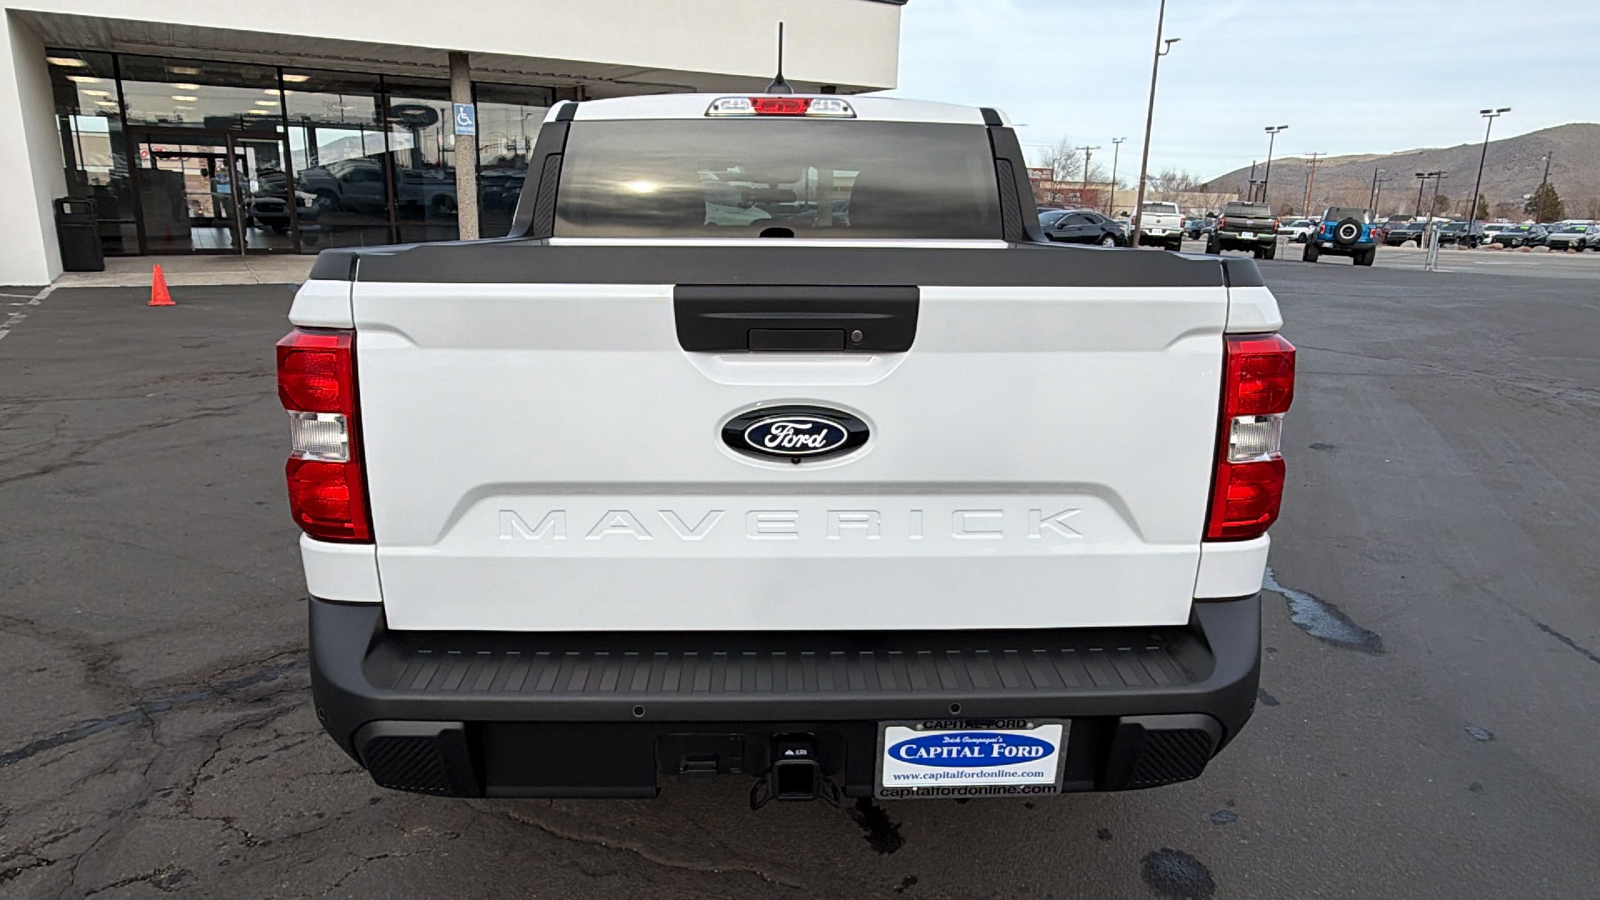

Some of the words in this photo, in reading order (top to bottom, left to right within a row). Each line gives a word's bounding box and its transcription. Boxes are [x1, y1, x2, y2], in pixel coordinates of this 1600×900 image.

[764, 423, 828, 448] Ford
[498, 509, 1085, 541] MAVERICK
[923, 719, 982, 729] CAPITAL
[986, 718, 1027, 729] FORD
[899, 744, 984, 759] CAPITAL
[991, 743, 1044, 758] FORD
[893, 770, 1044, 781] www.capitalfordonline.com
[879, 785, 1057, 799] capitalfordonline.com
